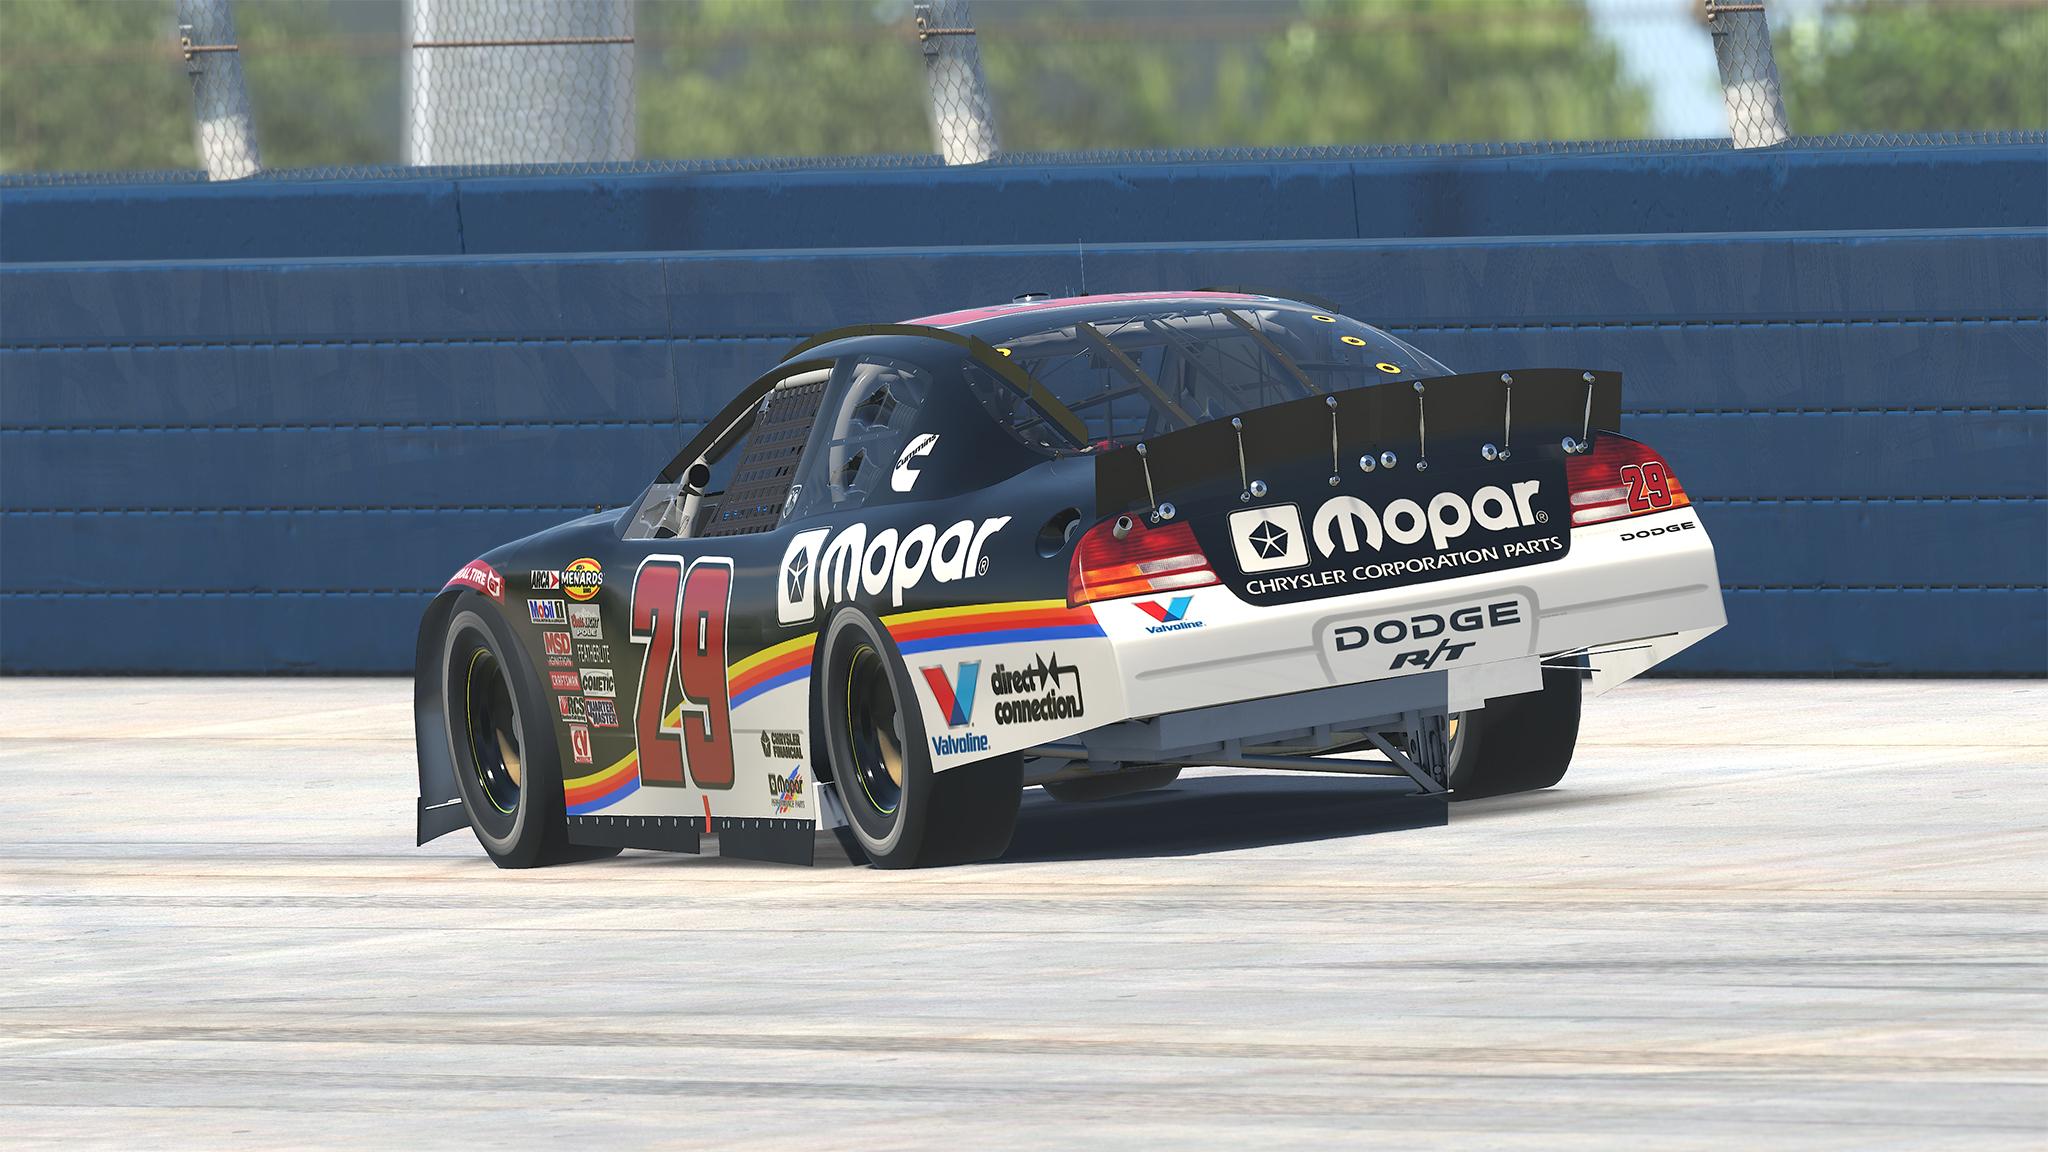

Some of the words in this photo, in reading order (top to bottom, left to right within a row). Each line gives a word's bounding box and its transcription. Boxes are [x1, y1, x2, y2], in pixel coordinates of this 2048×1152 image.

[896, 434, 937, 470] Cummins
[1619, 461, 1673, 513] 29
[1620, 521, 1696, 541] DODGE
[1246, 569, 1347, 595] CHRYSLER
[1352, 547, 1499, 580] CORPORATION
[1504, 536, 1563, 558] PARTS
[531, 570, 550, 589] ARCA
[561, 571, 604, 586] MENARDS
[529, 600, 554, 619] Mobil
[556, 601, 564, 618] 1
[1146, 619, 1204, 634] Valvoline
[1334, 600, 1521, 652] DODGE
[543, 632, 571, 654] MSD
[1389, 639, 1476, 670] R/T
[582, 674, 614, 692] COMETIC
[630, 554, 735, 790] 29
[991, 664, 1037, 695] direct
[995, 689, 1080, 725] connection
[573, 730, 588, 756] CV
[771, 732, 801, 746] CHRYSLER
[932, 732, 989, 756] Valvoline
